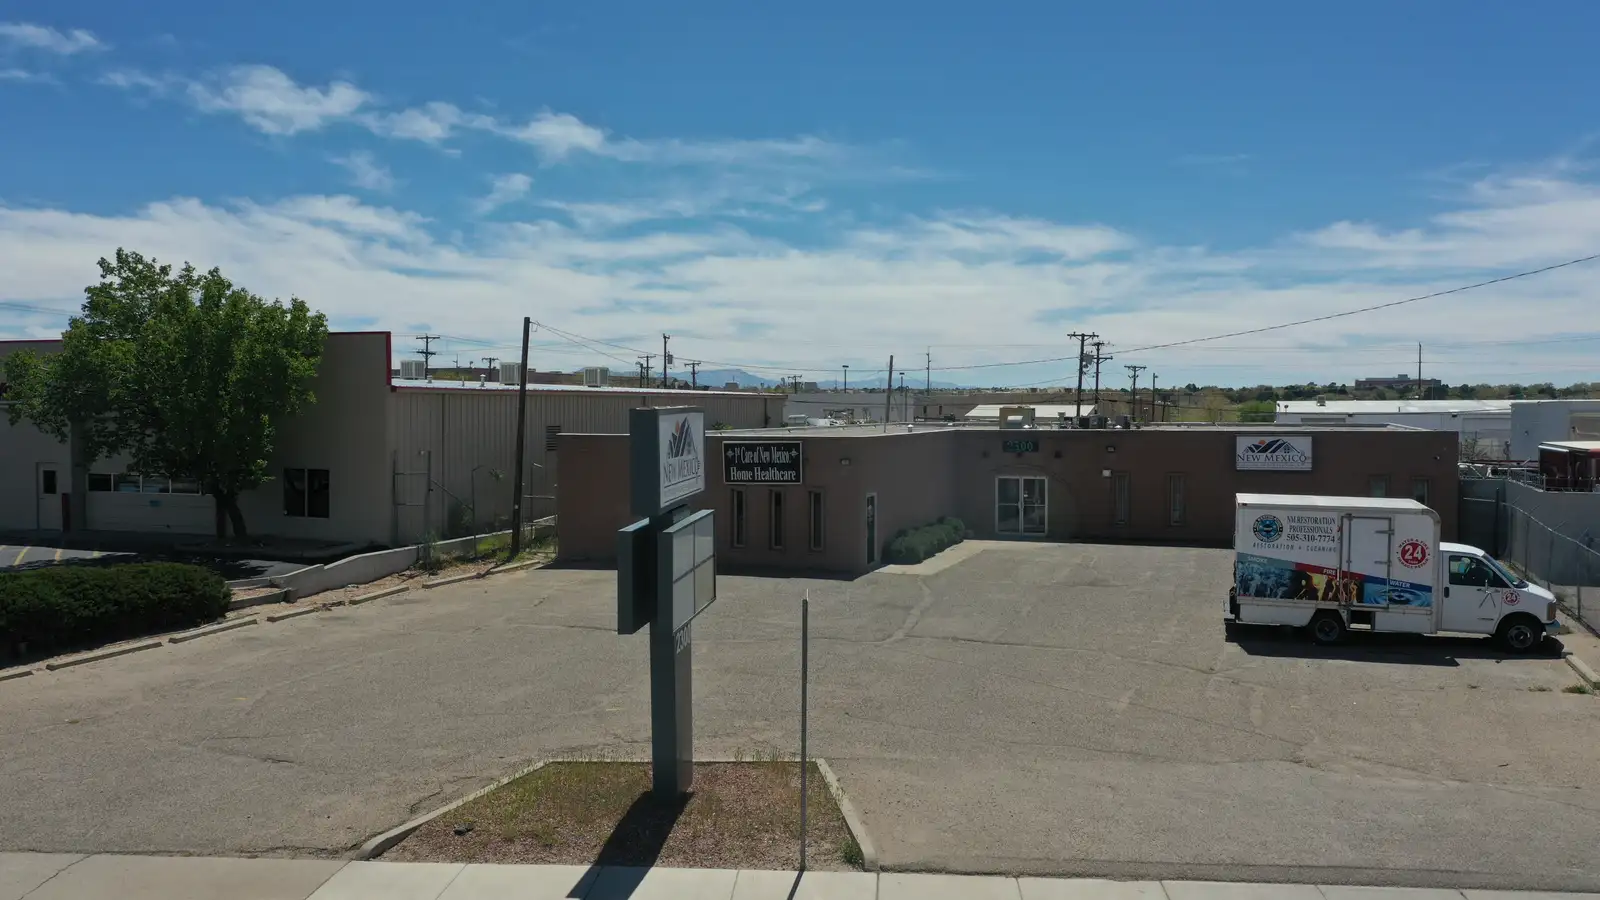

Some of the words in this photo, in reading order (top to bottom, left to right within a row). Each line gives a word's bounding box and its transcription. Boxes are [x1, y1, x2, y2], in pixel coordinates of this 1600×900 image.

[741, 446, 752, 463] Care
[760, 446, 770, 463] New
[1237, 454, 1260, 462] NEW
[1265, 453, 1307, 462] MEXICO
[663, 461, 677, 483] NEW
[678, 458, 698, 479] MEXICO
[730, 467, 752, 480] Home
[754, 467, 796, 480] Healthcare
[1297, 516, 1336, 525] RESTORATION
[1289, 525, 1333, 534] PROFESSIONALS
[1286, 533, 1336, 543] 505-310-7774
[1252, 542, 1294, 550] RESTORATION
[1404, 545, 1422, 560] 24
[1390, 580, 1410, 588] WATER
